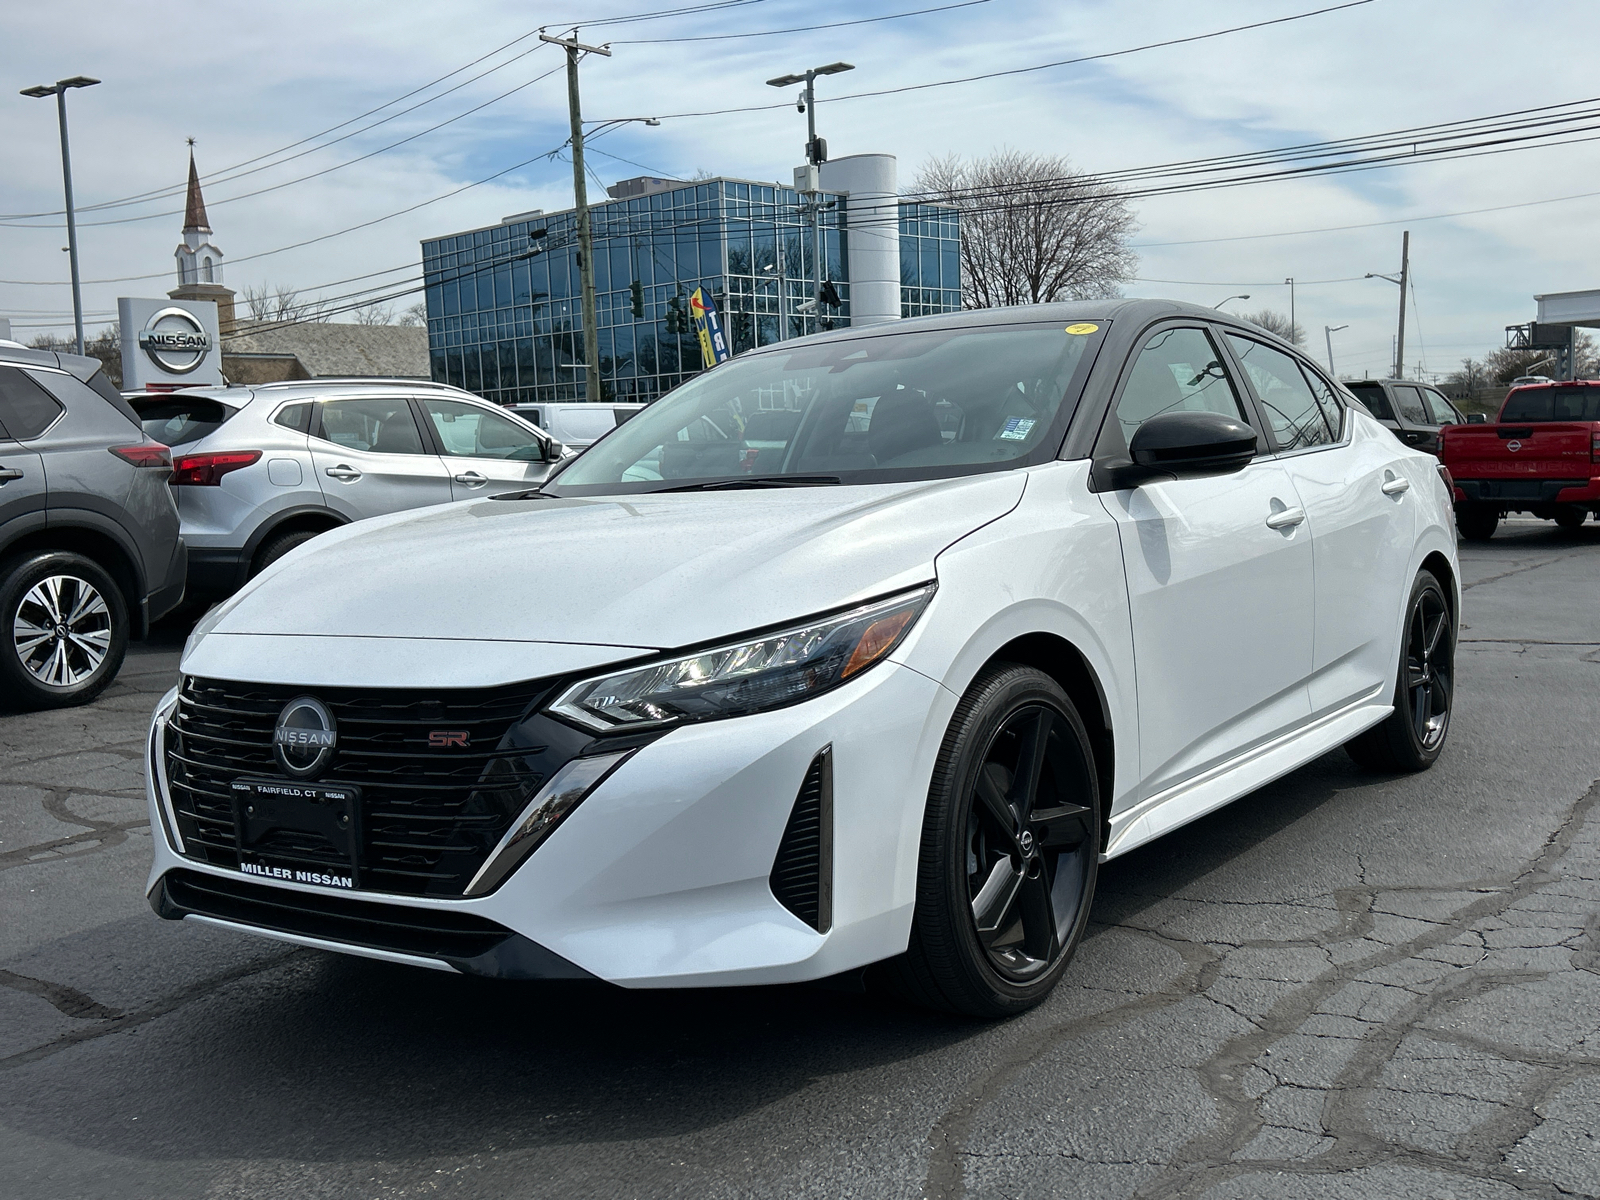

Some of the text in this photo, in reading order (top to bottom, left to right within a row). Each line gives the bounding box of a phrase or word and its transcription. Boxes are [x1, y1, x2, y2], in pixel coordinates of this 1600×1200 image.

[148, 335, 207, 346] NISSAN
[276, 729, 333, 745] NISSAN
[428, 731, 468, 747] SR
[257, 785, 317, 798] FAIRFIELD, CT
[325, 792, 346, 800] NISSAN
[240, 862, 353, 888] MILLER NISSAN
